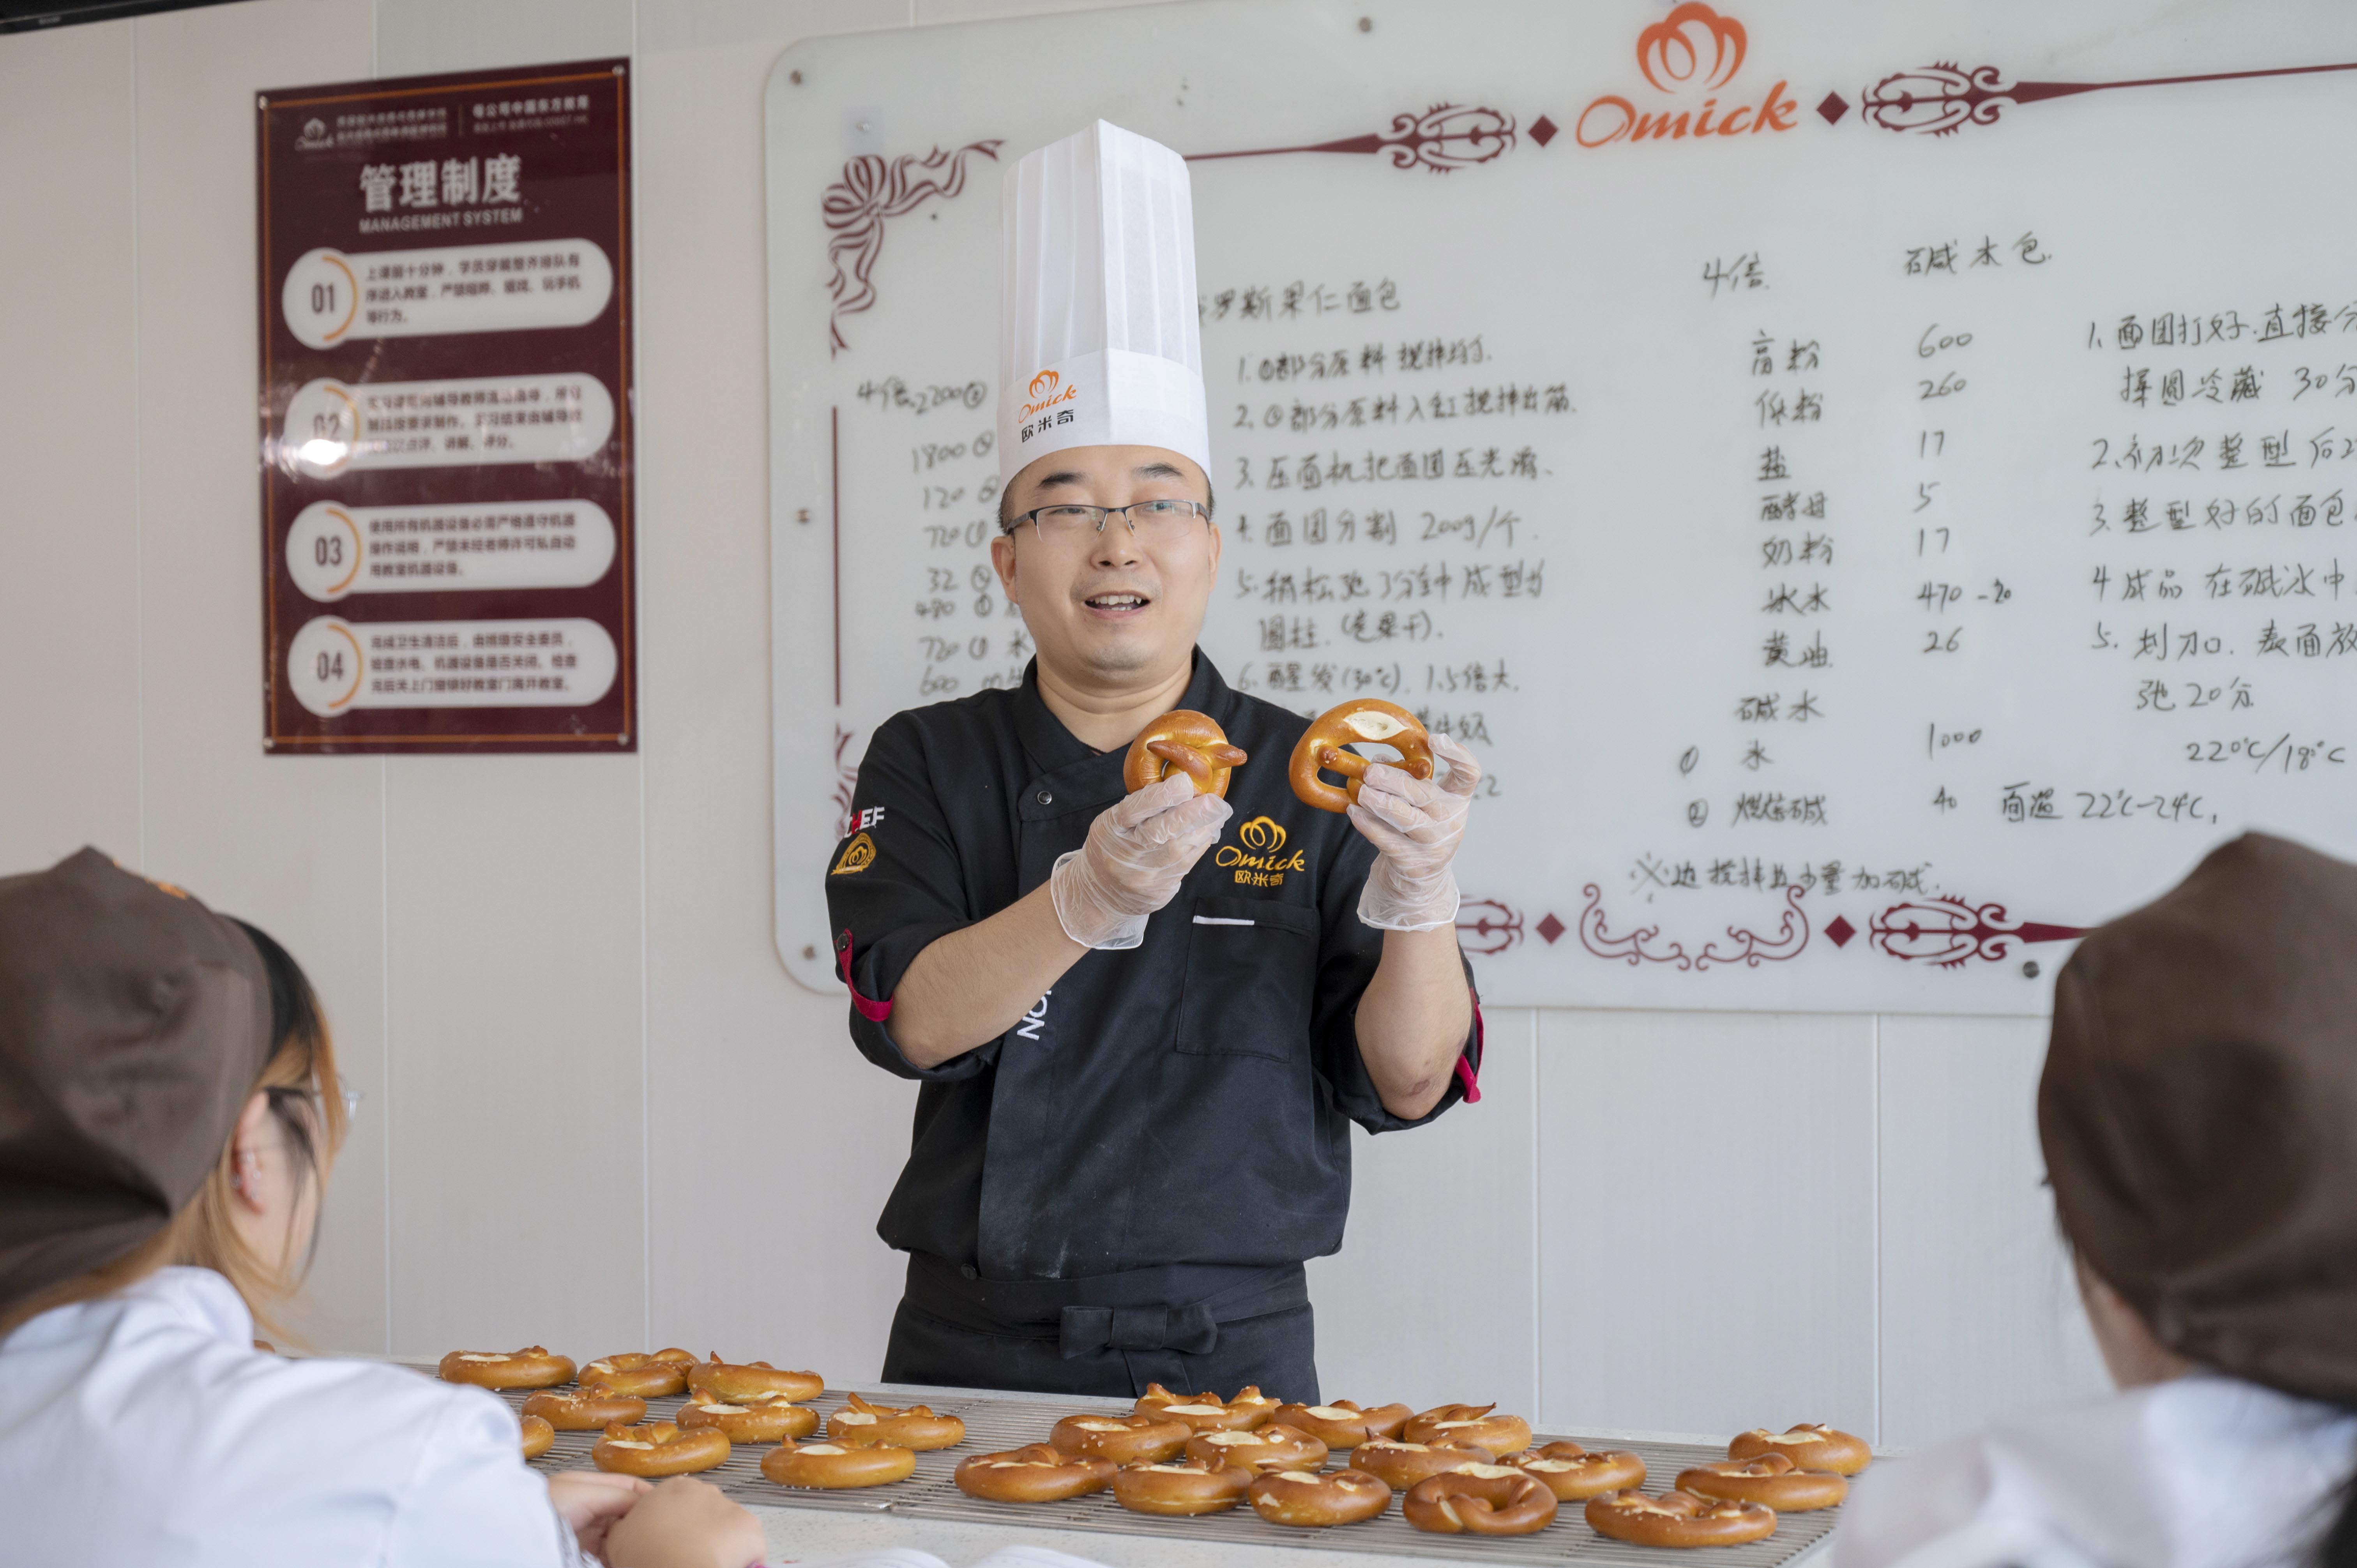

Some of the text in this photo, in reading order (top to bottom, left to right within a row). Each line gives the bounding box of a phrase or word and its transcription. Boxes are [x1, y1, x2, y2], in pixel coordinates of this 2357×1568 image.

[1576, 79, 1797, 148] Omick
[359, 153, 523, 213] 管理制度
[359, 207, 523, 235] MANAGEMENT SYSTEM
[311, 283, 335, 315] 01
[1917, 324, 1973, 358] 600
[1918, 371, 1968, 401] 260
[1019, 384, 1077, 424] Omick
[1022, 409, 1074, 443] 欧米奇
[1920, 430, 1946, 459] 17
[1914, 481, 1942, 513] 5
[315, 535, 342, 567] 03
[1918, 527, 1951, 556] 17
[1916, 580, 1963, 614] 470
[1922, 626, 1964, 655] 26
[316, 651, 344, 683] 04
[1927, 722, 1982, 759] 1000
[1216, 845, 1304, 872] Omick
[1234, 869, 1284, 887] 欧米奇
